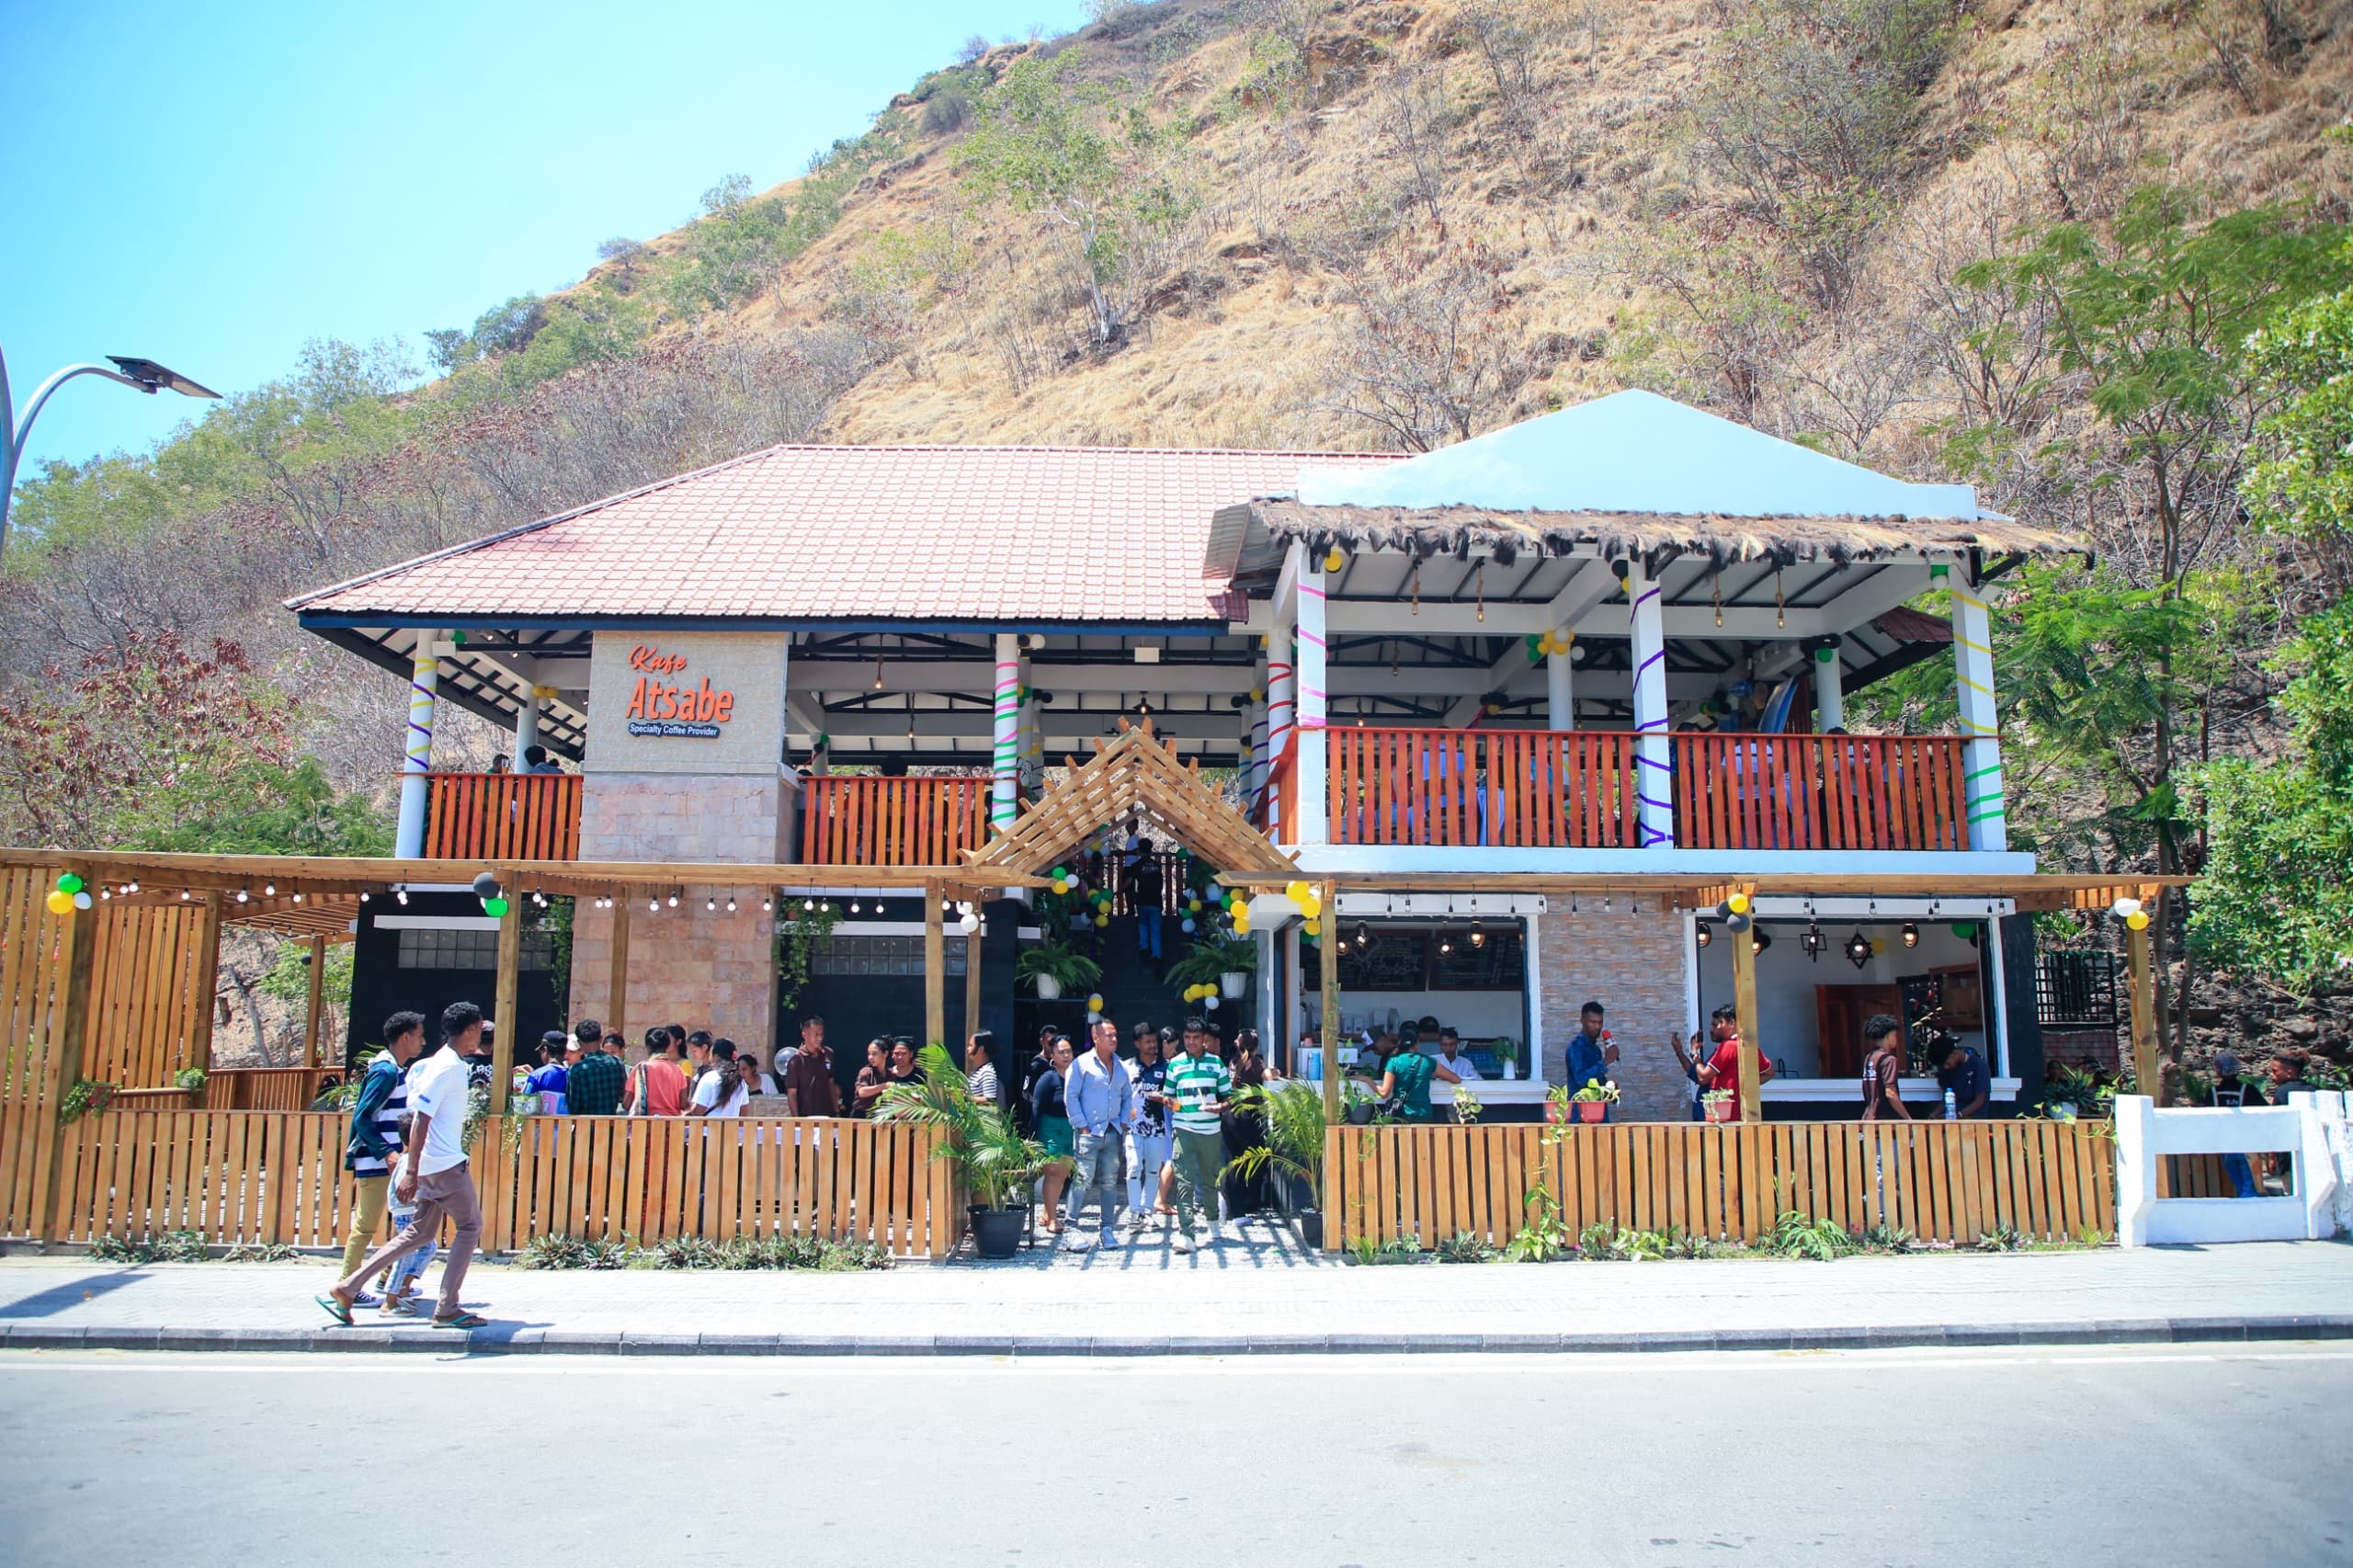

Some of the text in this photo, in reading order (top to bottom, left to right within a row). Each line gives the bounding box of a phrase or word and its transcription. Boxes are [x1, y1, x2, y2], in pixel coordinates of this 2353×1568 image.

[627, 644, 688, 675] Kafe
[626, 676, 733, 722] Atsabe
[630, 723, 718, 736] Specialty Coffee Provider
